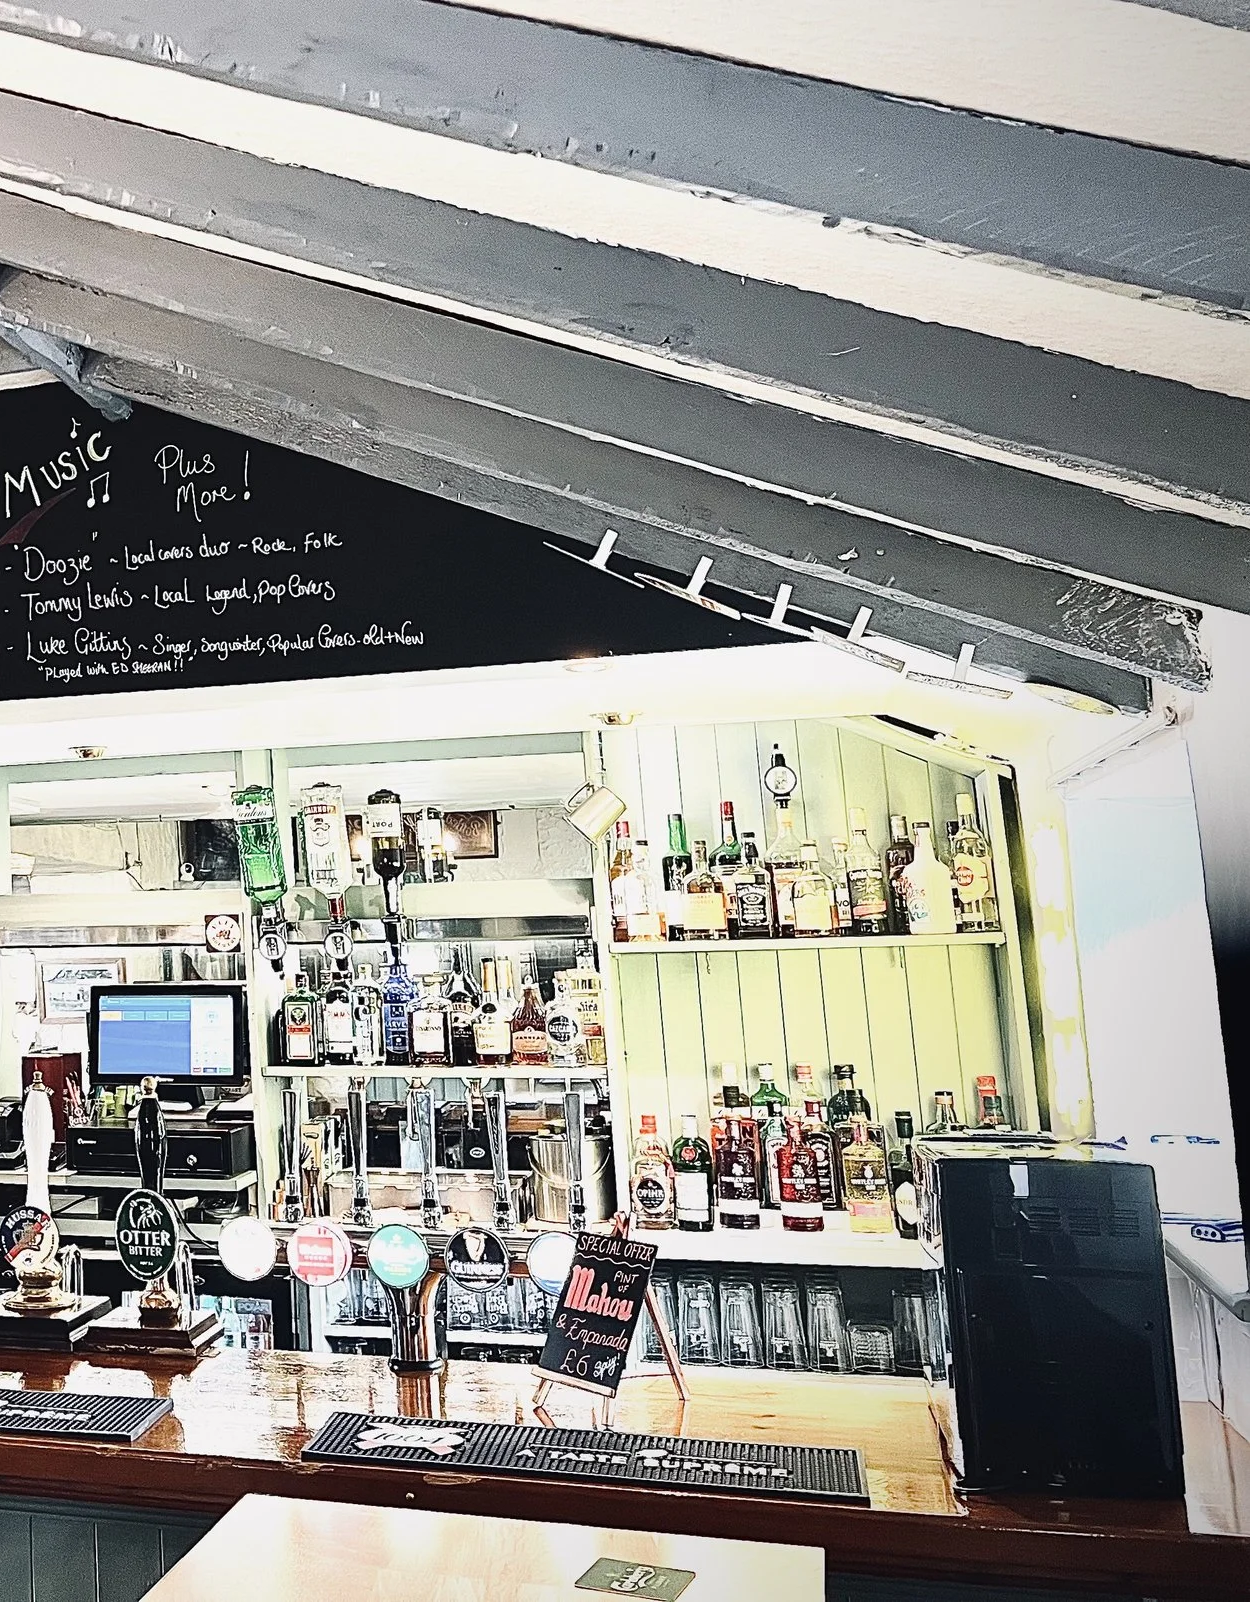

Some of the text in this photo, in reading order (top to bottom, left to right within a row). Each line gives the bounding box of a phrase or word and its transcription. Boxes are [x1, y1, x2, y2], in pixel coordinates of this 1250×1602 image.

[155, 445, 216, 484] Plus
[125, 540, 155, 570] Local
[158, 544, 193, 561] covers
[200, 533, 230, 558] duo
[305, 532, 342, 553] Folk
[21, 593, 81, 621] Tommy
[88, 582, 132, 609] Lewis
[27, 632, 69, 663] Luke
[153, 634, 197, 658] Singer,
[267, 634, 314, 656] Popular
[86, 662, 108, 675] with
[112, 662, 129, 674] ED
[119, 1229, 172, 1246] OTTER
[128, 1245, 163, 1257] BITTER
[578, 1235, 655, 1262] SPECIAL OFFER
[614, 1271, 639, 1284] PINT
[618, 1285, 628, 1293] OF
[563, 1265, 634, 1321] Mahou
[556, 1313, 629, 1352] & Empanada
[560, 1349, 590, 1376] £6
[549, 1450, 628, 1465] TASTE
